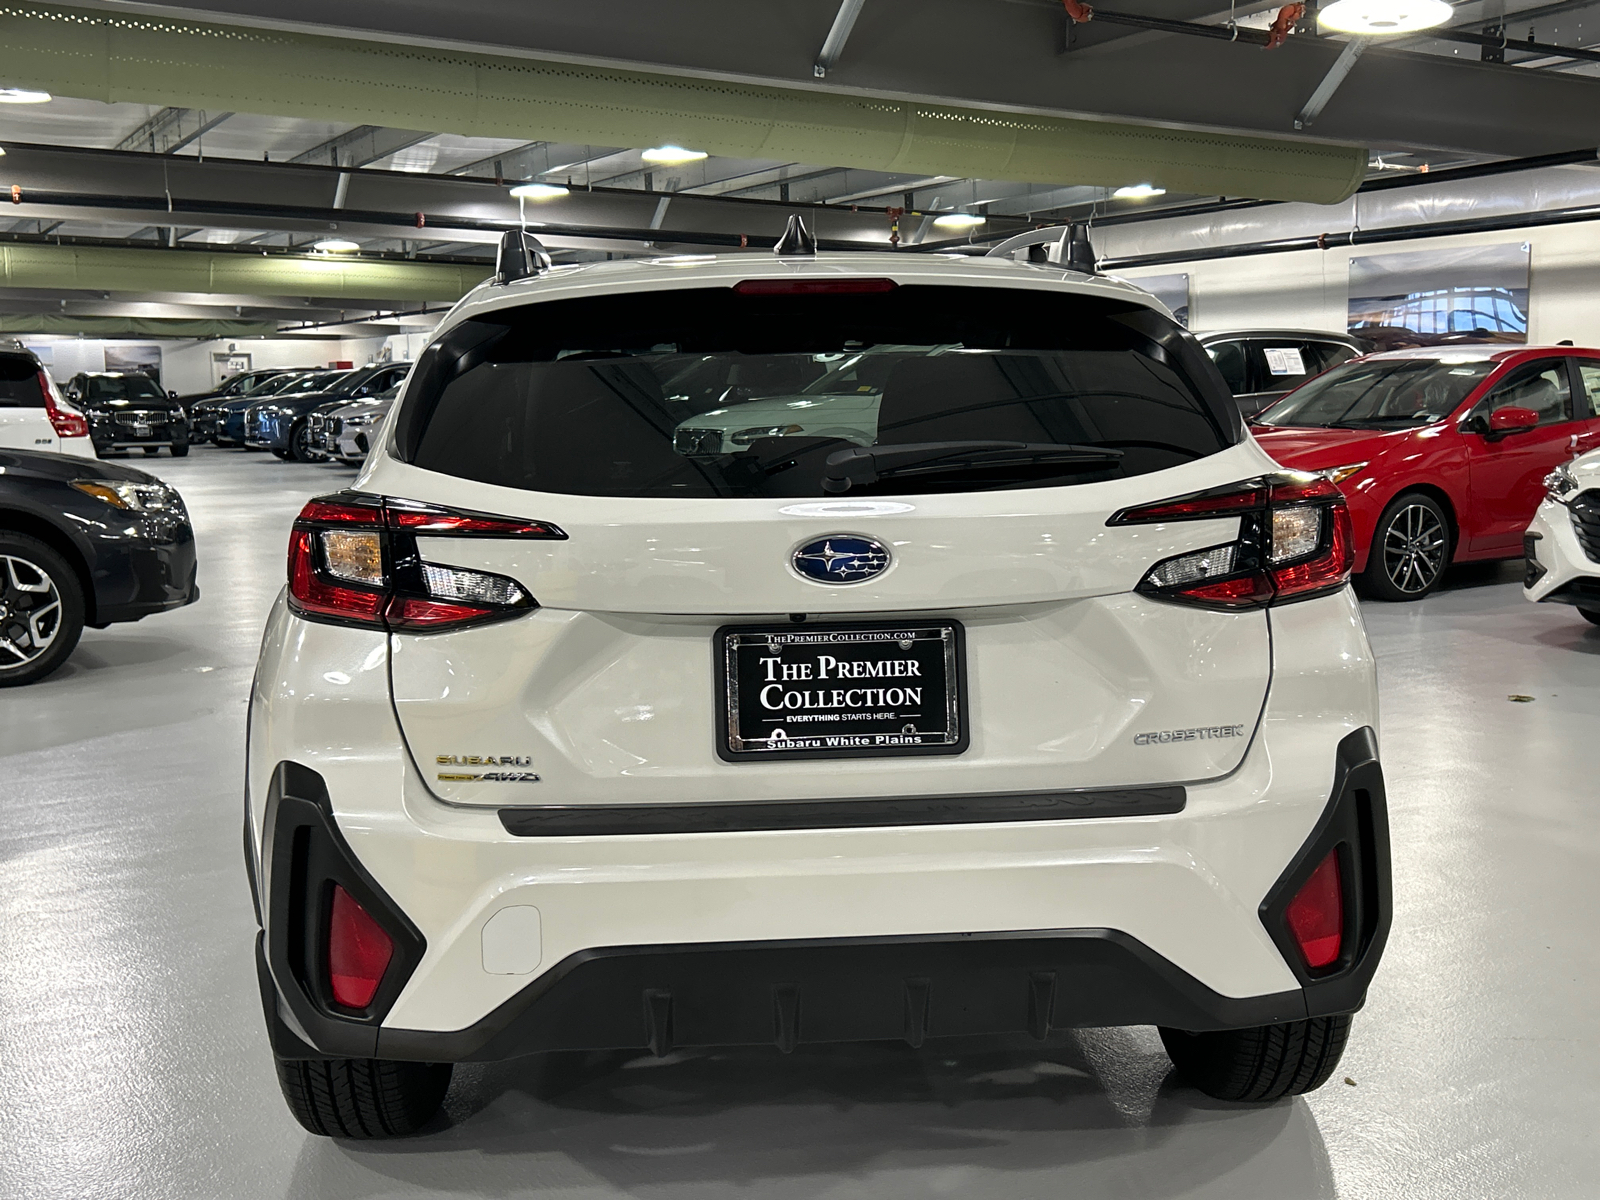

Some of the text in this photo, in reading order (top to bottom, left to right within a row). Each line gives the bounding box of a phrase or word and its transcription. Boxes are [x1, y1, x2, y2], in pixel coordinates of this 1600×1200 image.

[765, 631, 916, 643] THEPREMIERCOLLECTION.COM
[759, 655, 922, 682] THE PREMIER
[759, 683, 922, 710] COLLECTION
[786, 713, 840, 722] EVERYTHING
[841, 712, 872, 721] STARTS
[1133, 723, 1244, 746] CROSSTREK
[767, 735, 922, 749] Subaru White Plains
[436, 755, 532, 767] SUBARU
